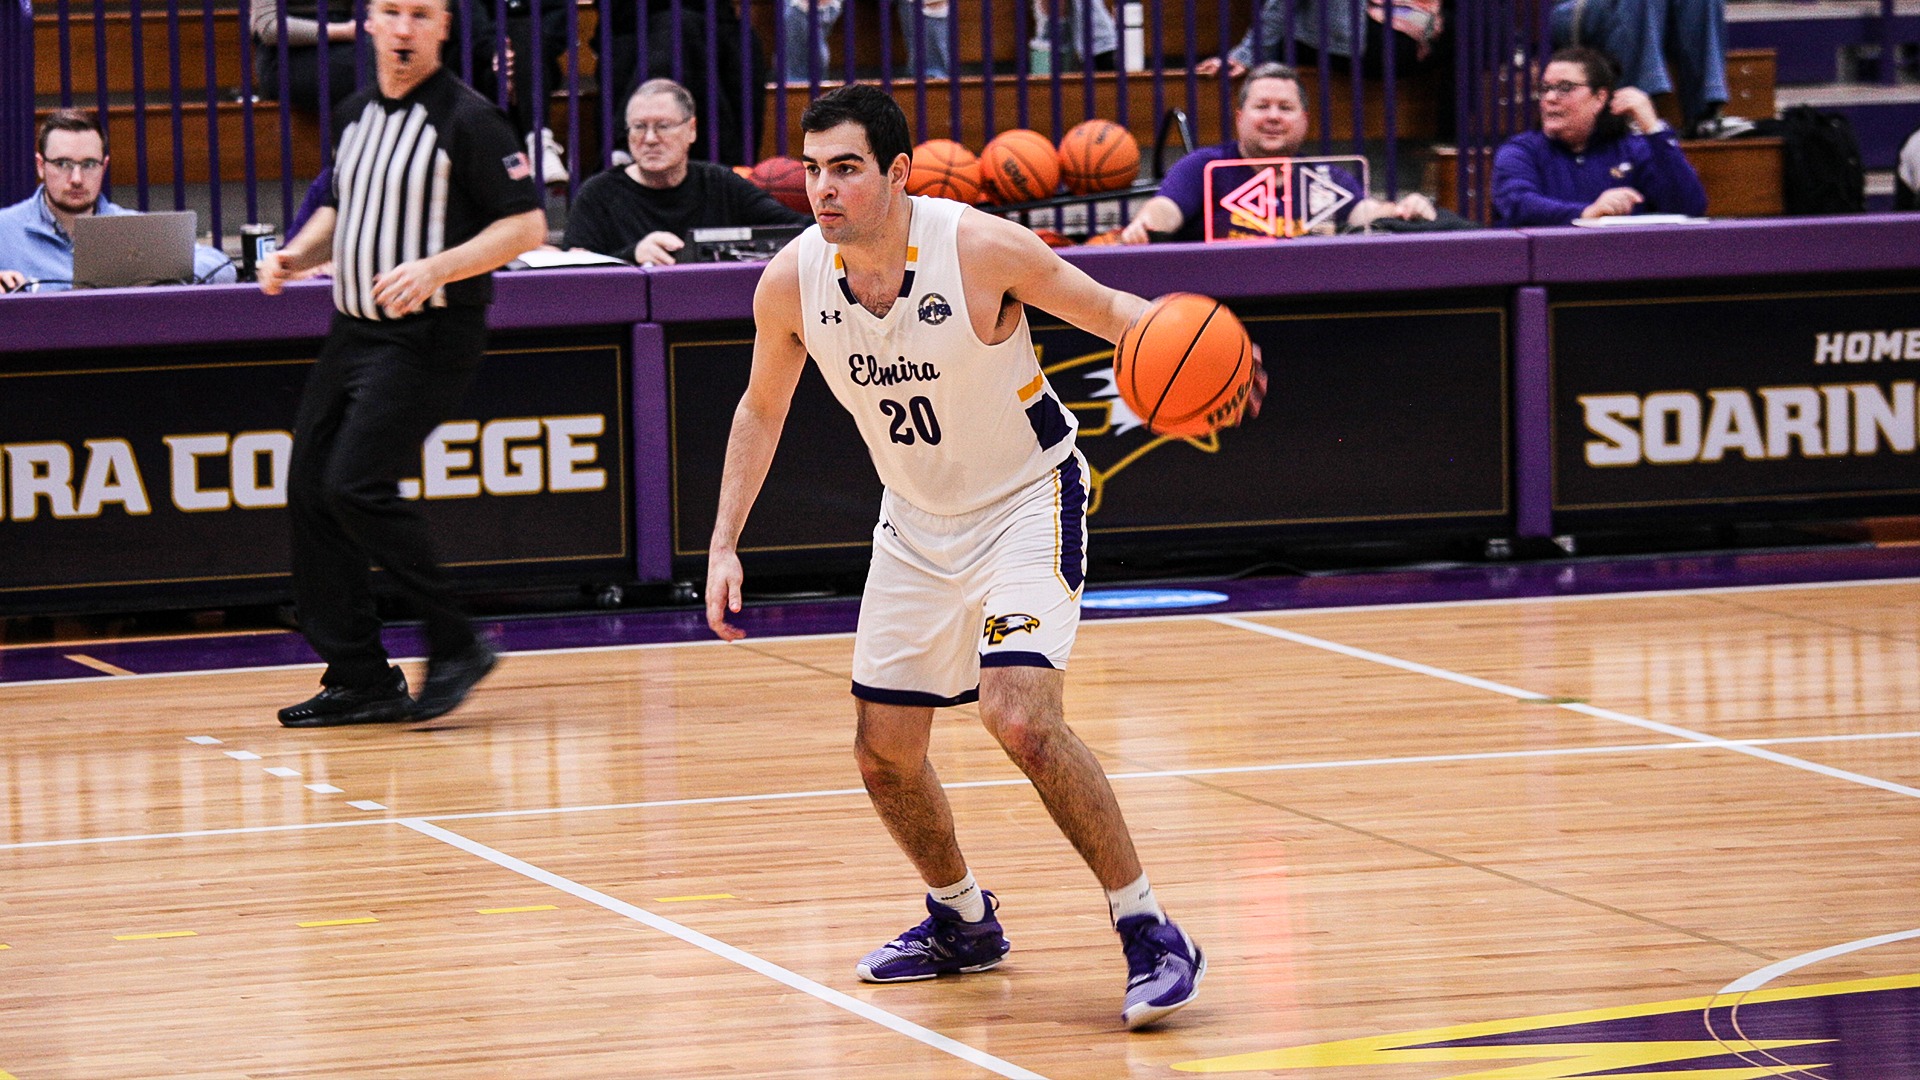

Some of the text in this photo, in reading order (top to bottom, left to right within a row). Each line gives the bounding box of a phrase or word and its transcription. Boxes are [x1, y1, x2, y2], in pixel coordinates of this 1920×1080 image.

[848, 353, 941, 387] Elmira
[878, 395, 942, 446] 20
[1577, 381, 1920, 468] SOARIN
[0, 413, 607, 523] RA COEGE
